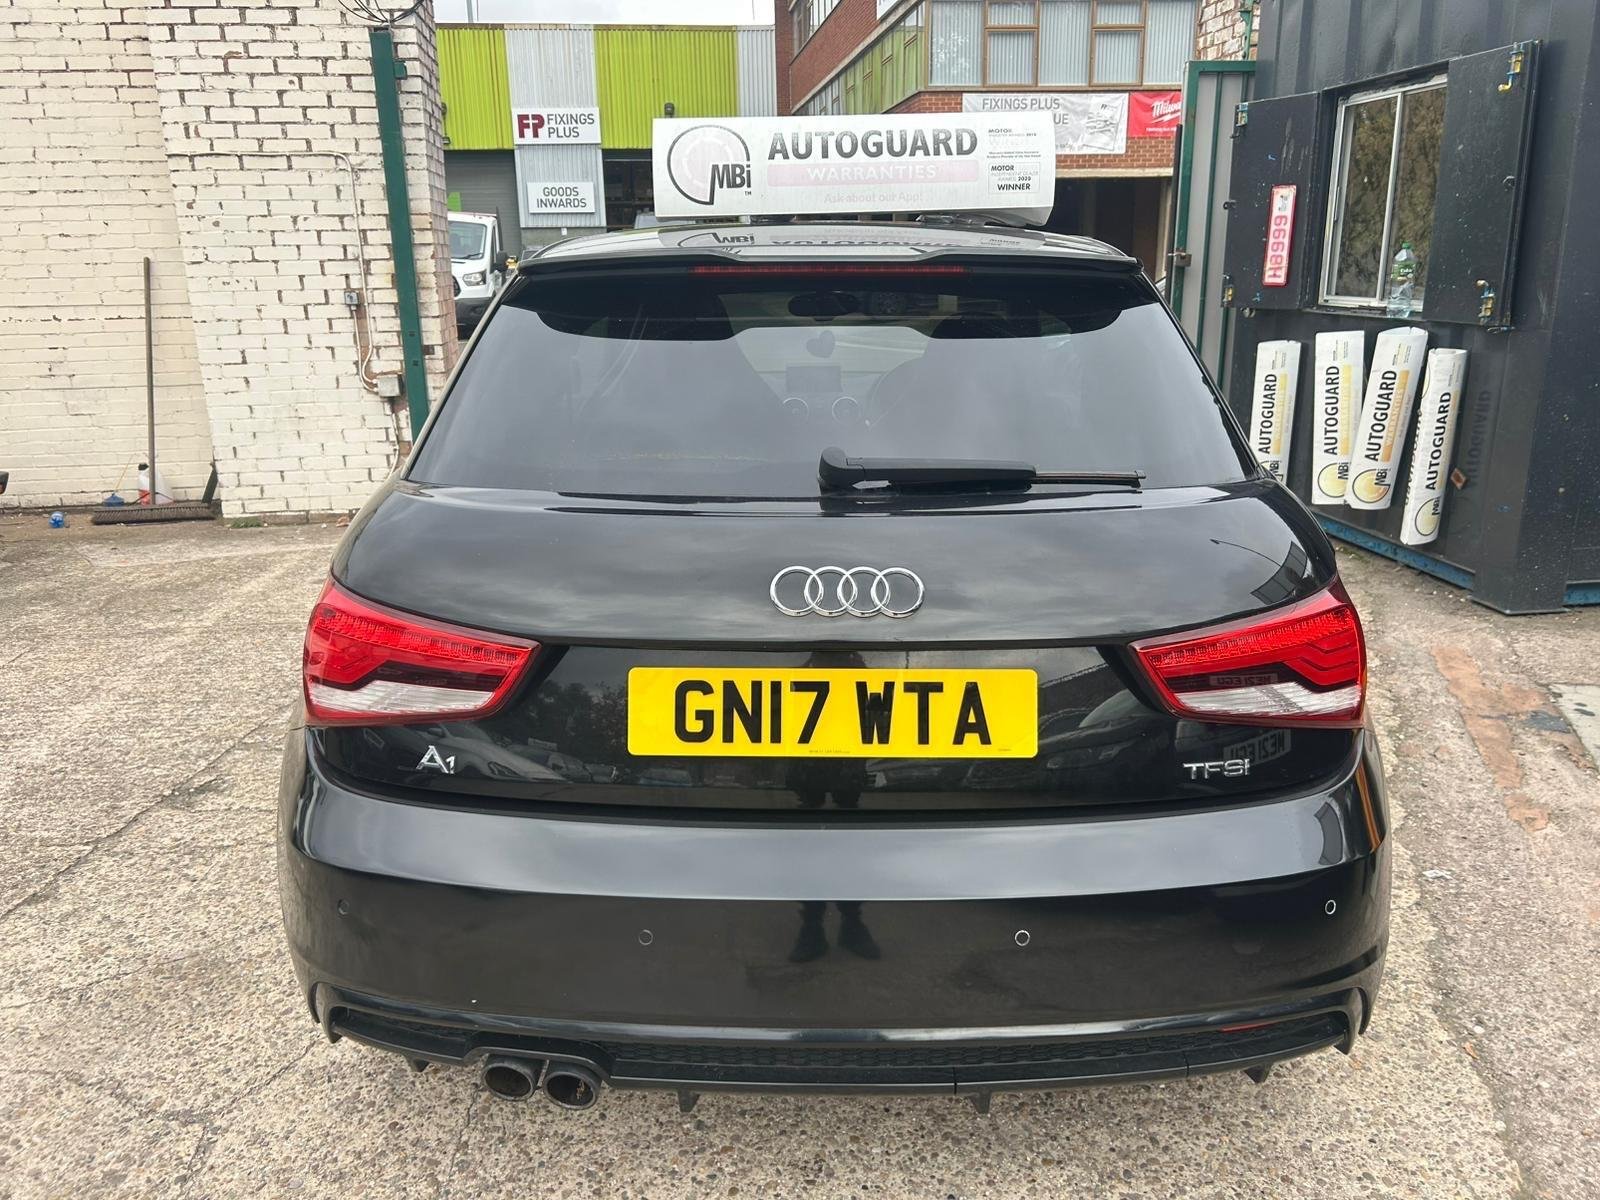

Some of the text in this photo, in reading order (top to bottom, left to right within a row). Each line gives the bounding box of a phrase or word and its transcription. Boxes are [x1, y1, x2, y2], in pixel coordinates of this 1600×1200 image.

[981, 97, 1061, 111] FIXINGS PLUS
[516, 113, 545, 139] FP
[546, 113, 595, 126] FIXINGS
[547, 126, 580, 139] PLUS
[767, 128, 979, 161] AUTOGUARD
[806, 164, 938, 182] WARRANTIES
[542, 186, 579, 198] GOODS
[996, 183, 1031, 191] WINNER
[536, 197, 587, 209] INWARDS
[1258, 373, 1277, 455] AUTOGUARD
[1324, 365, 1340, 456] AUTOGUARD
[1364, 370, 1397, 462] AUTOGUARD
[1425, 391, 1452, 491] AUTOGUARD
[673, 679, 992, 746] GN17 WTA
[415, 745, 456, 775] A1
